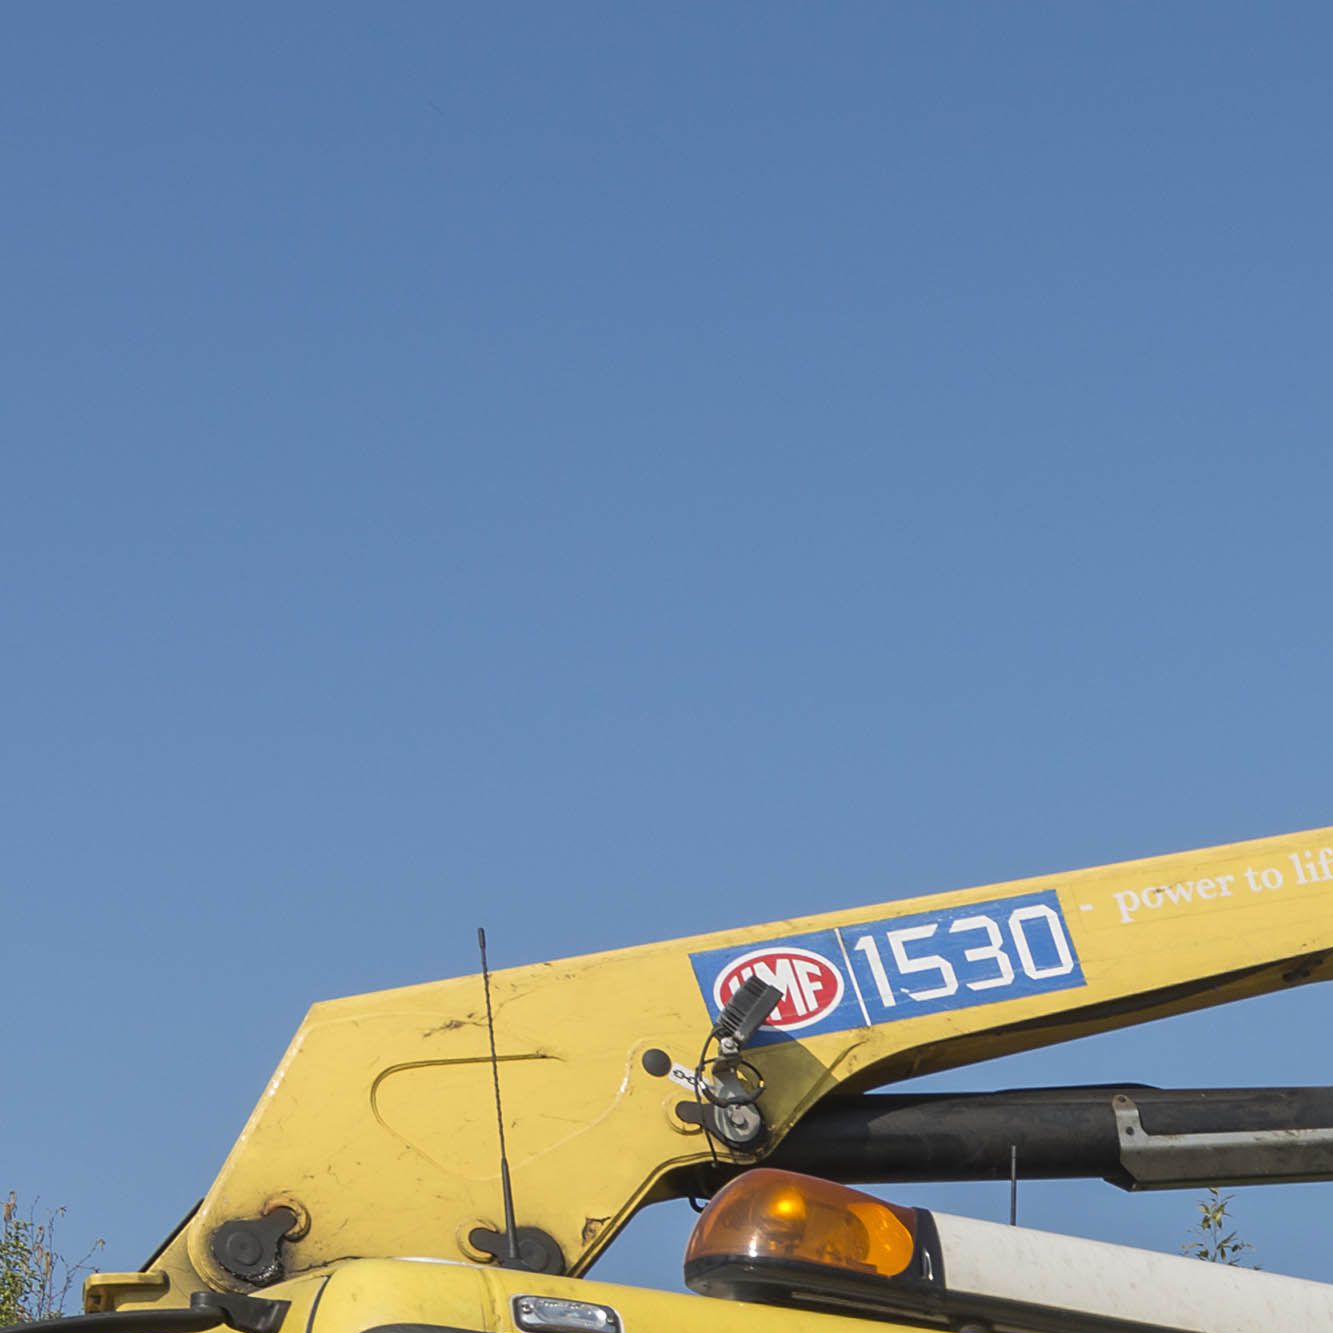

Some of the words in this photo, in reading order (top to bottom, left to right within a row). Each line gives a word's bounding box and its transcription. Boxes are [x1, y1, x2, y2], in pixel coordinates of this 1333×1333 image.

[1112, 873, 1235, 924] power
[1243, 865, 1284, 893] to
[853, 904, 1076, 1008] 1530
